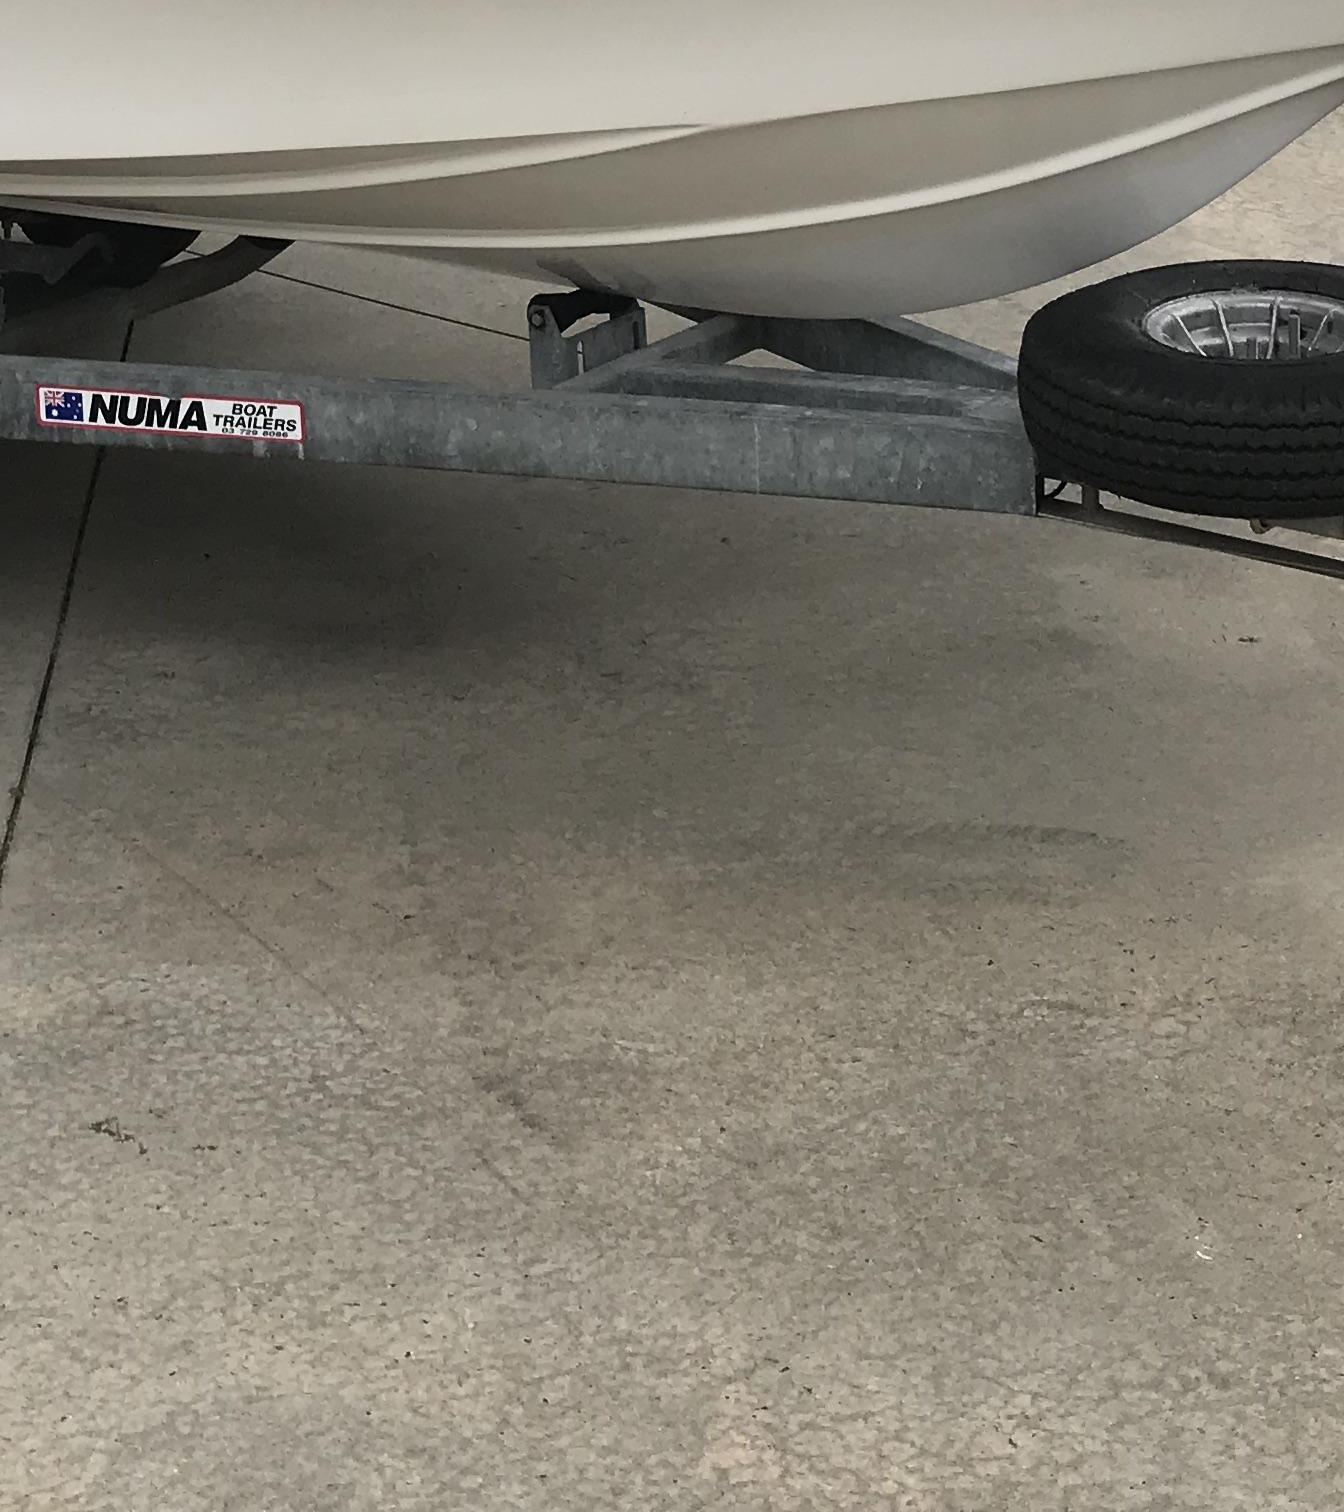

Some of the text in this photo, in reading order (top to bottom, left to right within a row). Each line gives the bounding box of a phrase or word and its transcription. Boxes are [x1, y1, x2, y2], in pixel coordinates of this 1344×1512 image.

[89, 393, 208, 431] NUMA
[232, 403, 277, 418] BOAT
[213, 414, 297, 432] TRAILERS
